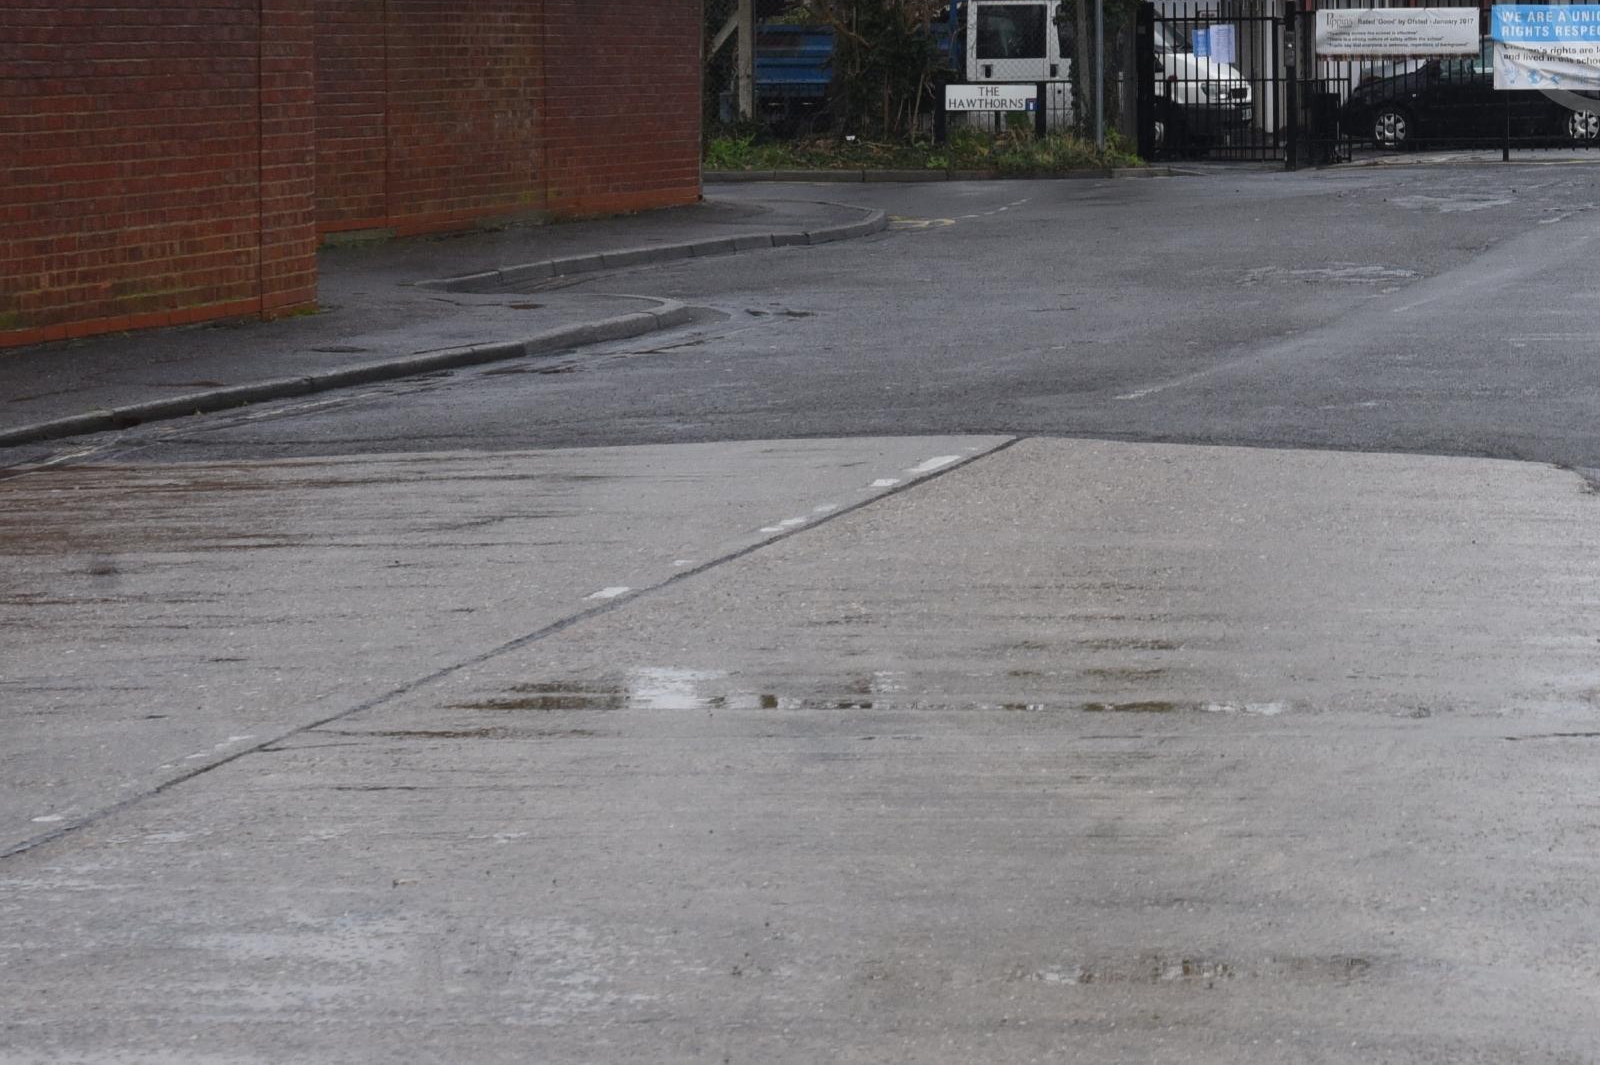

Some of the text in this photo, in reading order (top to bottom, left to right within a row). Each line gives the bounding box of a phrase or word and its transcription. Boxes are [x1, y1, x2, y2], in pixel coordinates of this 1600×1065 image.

[1433, 18, 1458, 26] January
[1502, 11, 1522, 23] WE
[1527, 11, 1553, 23] ARE
[1558, 11, 1567, 22] A
[1501, 25, 1550, 37] RIGHTS
[1550, 46, 1577, 56] rights
[1503, 53, 1520, 61] and
[1523, 53, 1545, 62] lived
[977, 86, 1000, 97] THE
[948, 98, 1024, 109] HAWTHORNS
